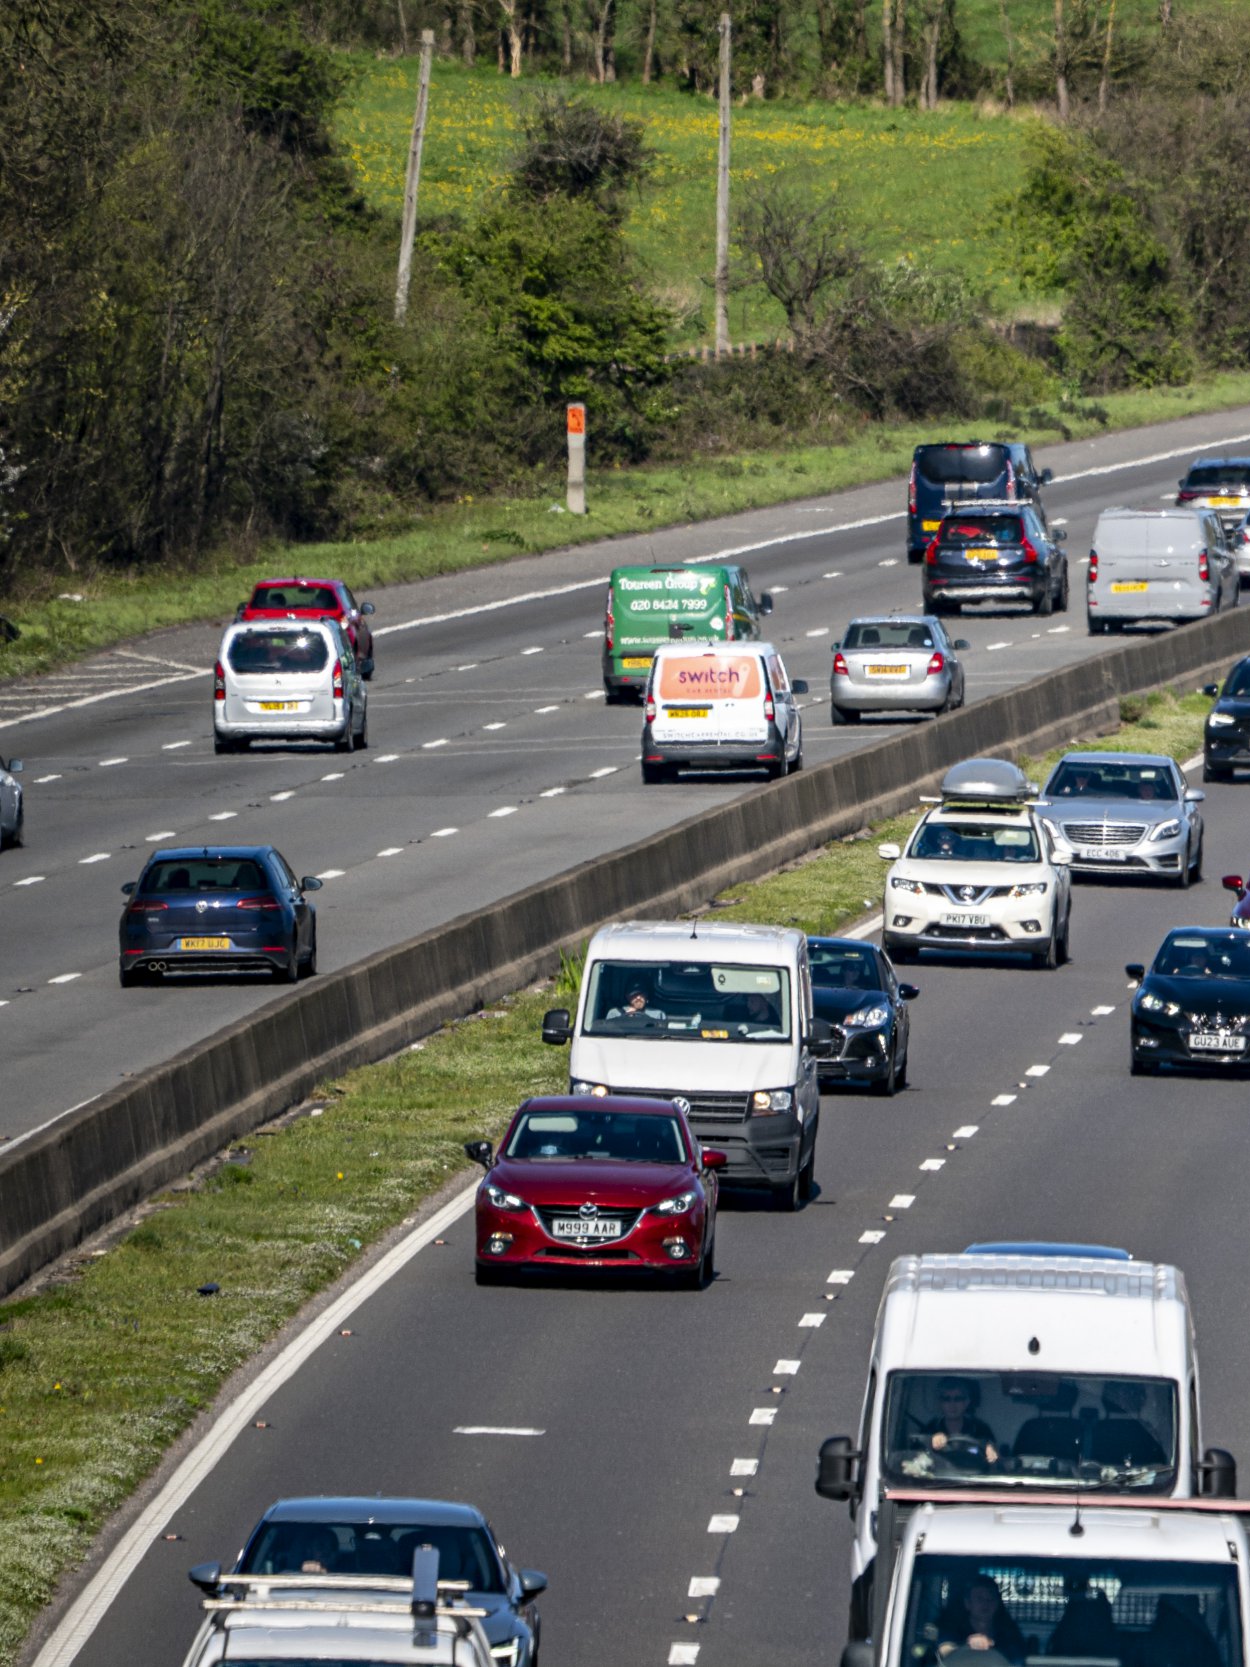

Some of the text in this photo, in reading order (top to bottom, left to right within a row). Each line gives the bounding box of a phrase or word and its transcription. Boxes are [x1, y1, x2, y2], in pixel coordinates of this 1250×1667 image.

[630, 599, 651, 610] 020
[679, 668, 740, 684] switch
[946, 915, 966, 925] PK17
[1194, 1037, 1241, 1048] GU23 AUE
[557, 1223, 616, 1234] M999 AAR
